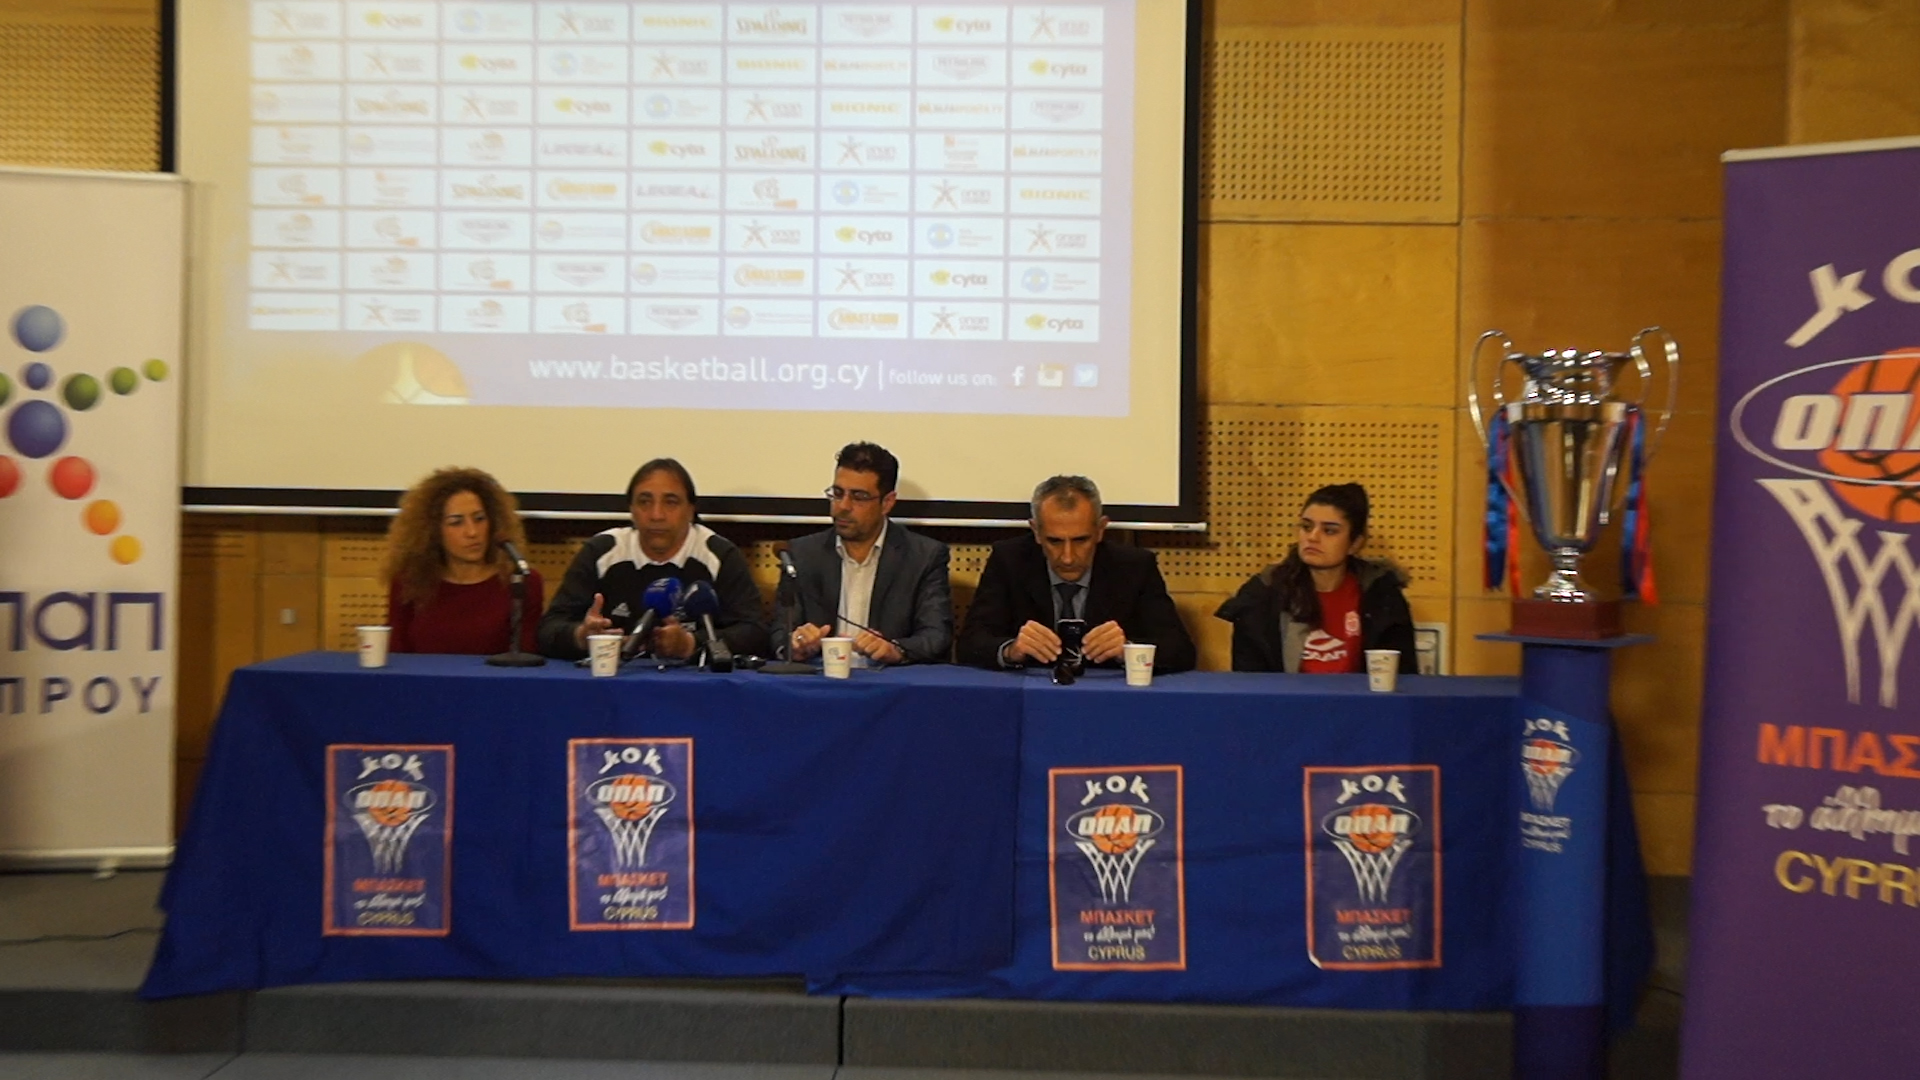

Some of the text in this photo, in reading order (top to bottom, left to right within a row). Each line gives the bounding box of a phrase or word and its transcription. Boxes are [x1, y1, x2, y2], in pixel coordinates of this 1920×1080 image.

[956, 19, 991, 34] cyta
[1050, 63, 1087, 78] cyta
[857, 230, 893, 245] cyta
[951, 272, 988, 288] cyta
[1047, 318, 1084, 334] cyta
[529, 354, 870, 390] www.basketball.org.cy
[888, 370, 942, 387] follow
[948, 372, 967, 387] us
[597, 784, 667, 803] ΟΠΑΠ
[1077, 814, 1153, 836] ΟΠΑΠ
[1774, 850, 1920, 908] CYPR
[1079, 909, 1155, 924] ΜΠΑΣΚΕΤ
[1088, 945, 1146, 961] CYPRUS
